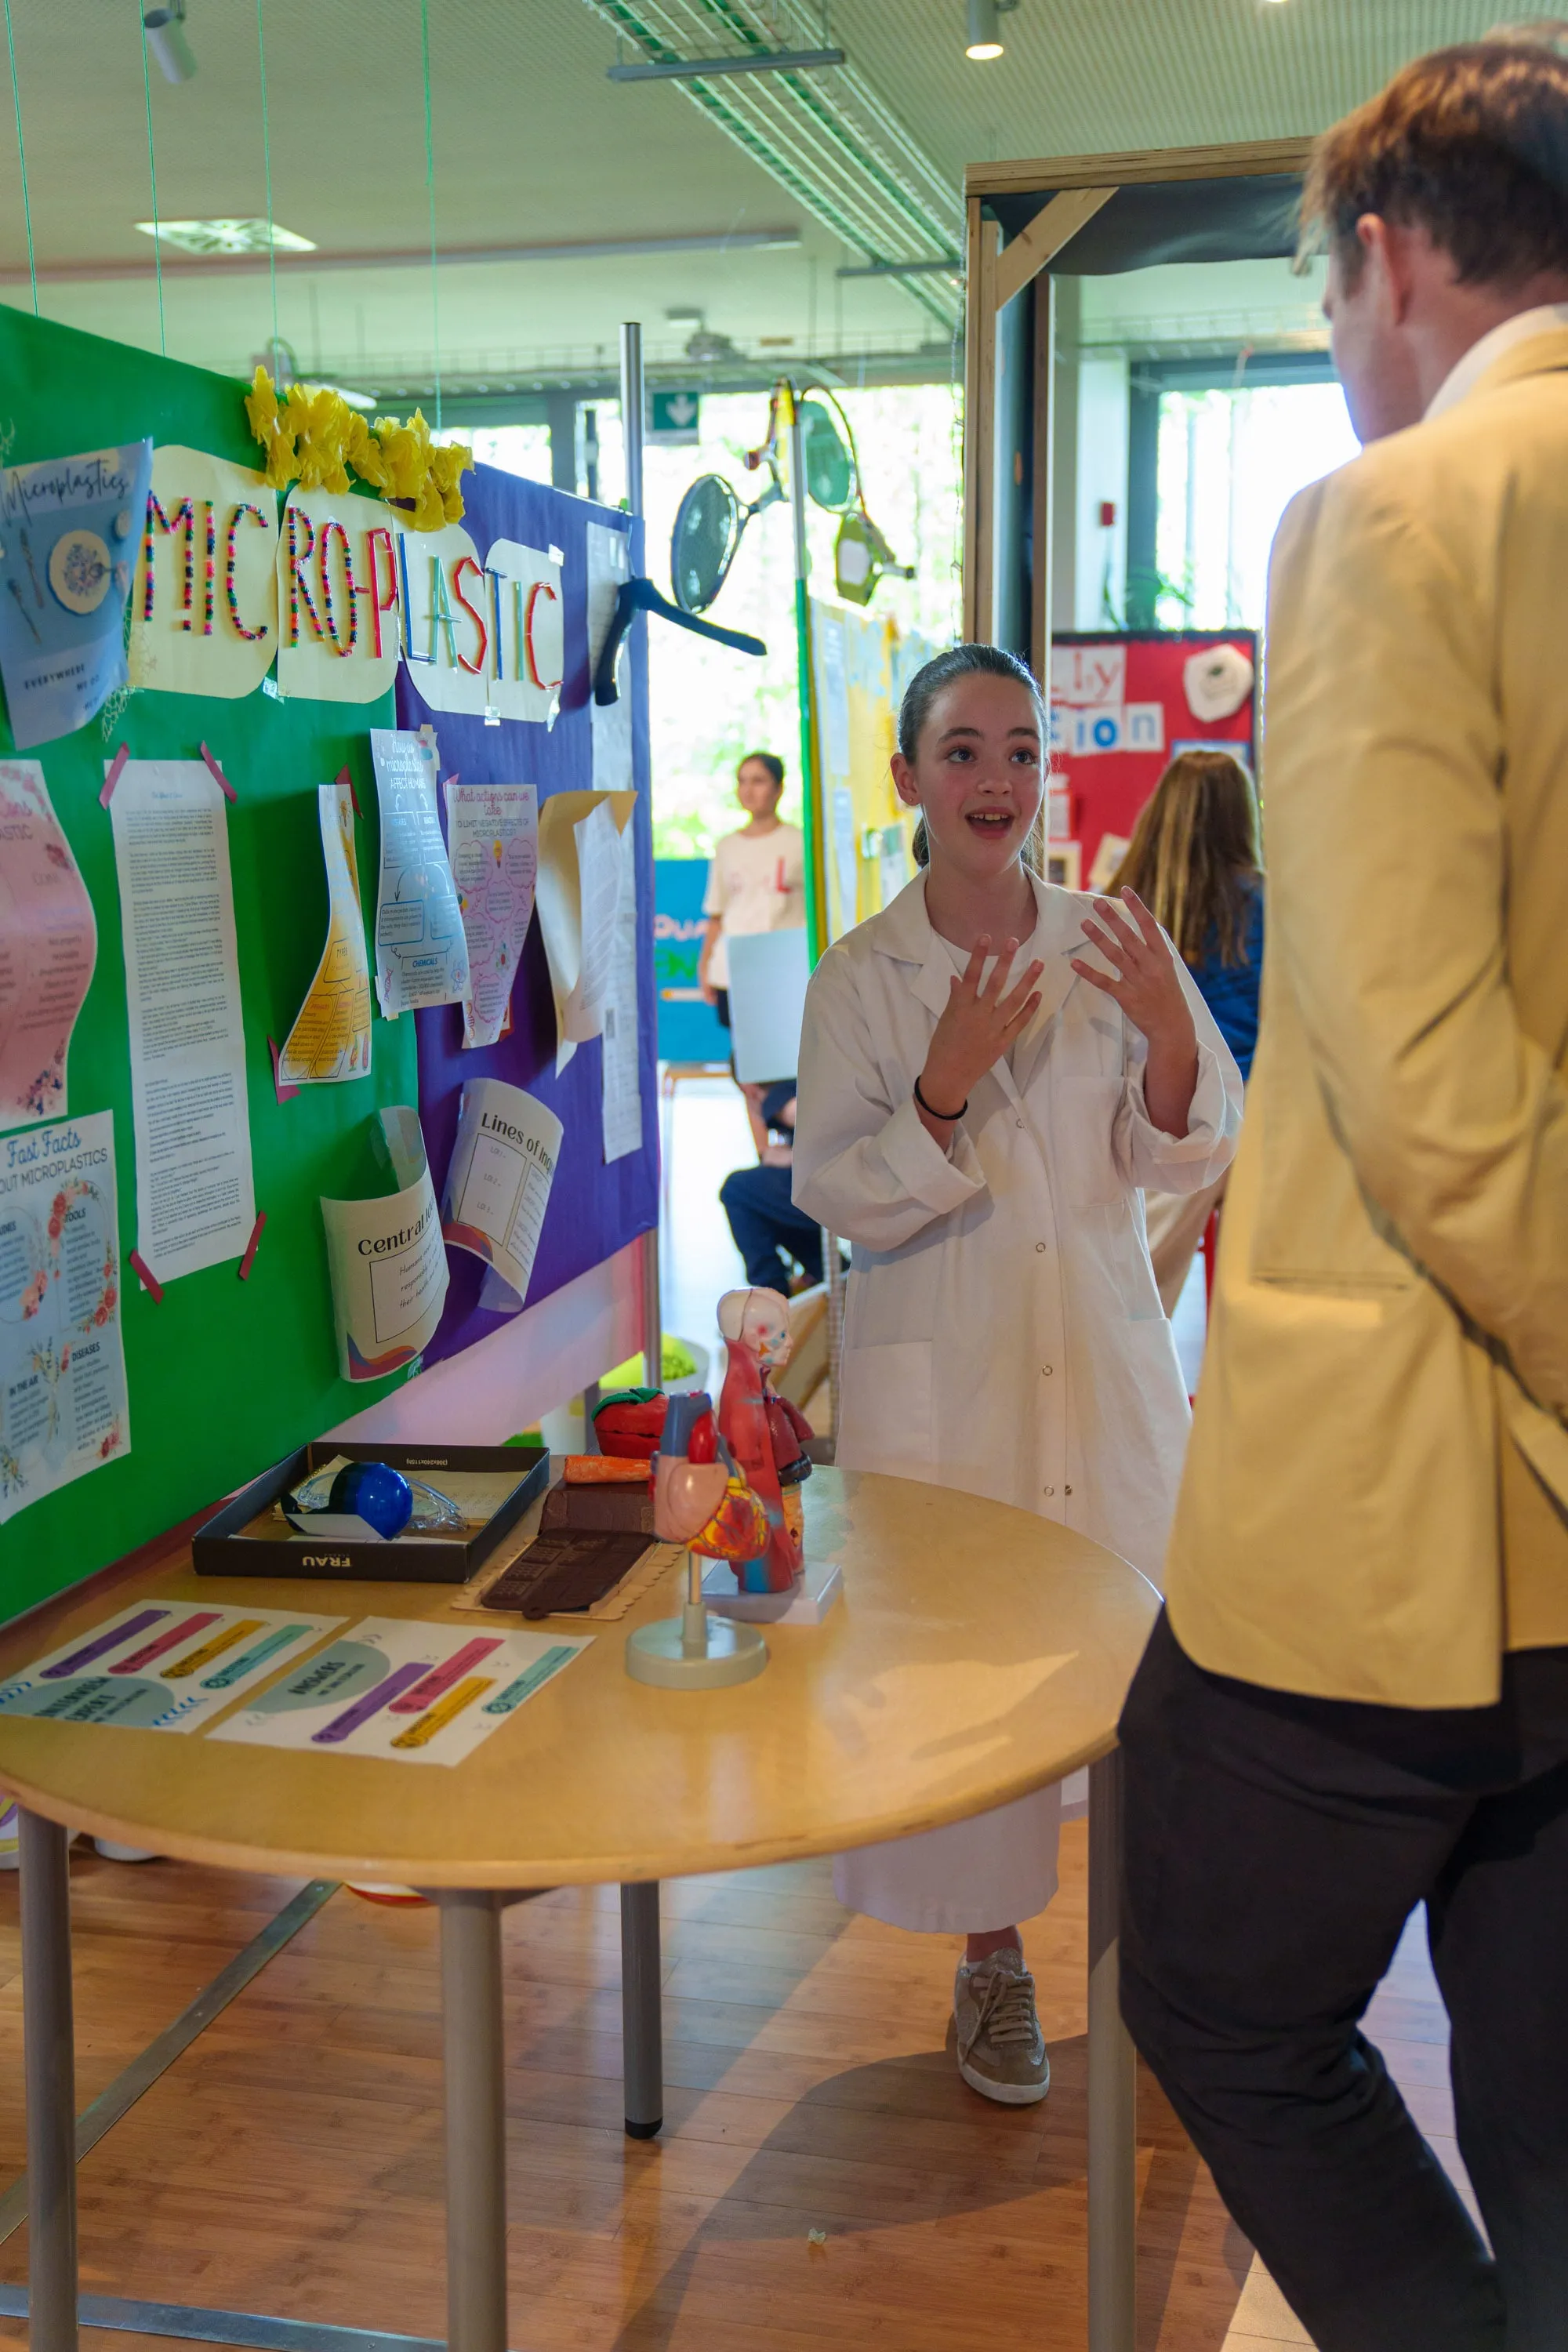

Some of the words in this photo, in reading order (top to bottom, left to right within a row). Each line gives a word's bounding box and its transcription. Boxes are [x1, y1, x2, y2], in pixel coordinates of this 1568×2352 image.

[1051, 651, 1122, 699] ly
[452, 787, 476, 803] What
[519, 792, 530, 800] we
[484, 804, 502, 815] take
[412, 957, 438, 968] CHEMICALS
[7, 1139, 38, 1168] Fast
[41, 1127, 82, 1158] Facts
[481, 1112, 524, 1145] Lines
[526, 1138, 540, 1156] of
[21, 1147, 108, 1185] MICROPLASTICS
[358, 1214, 424, 1256] Central
[302, 1555, 350, 1566] FRAU
